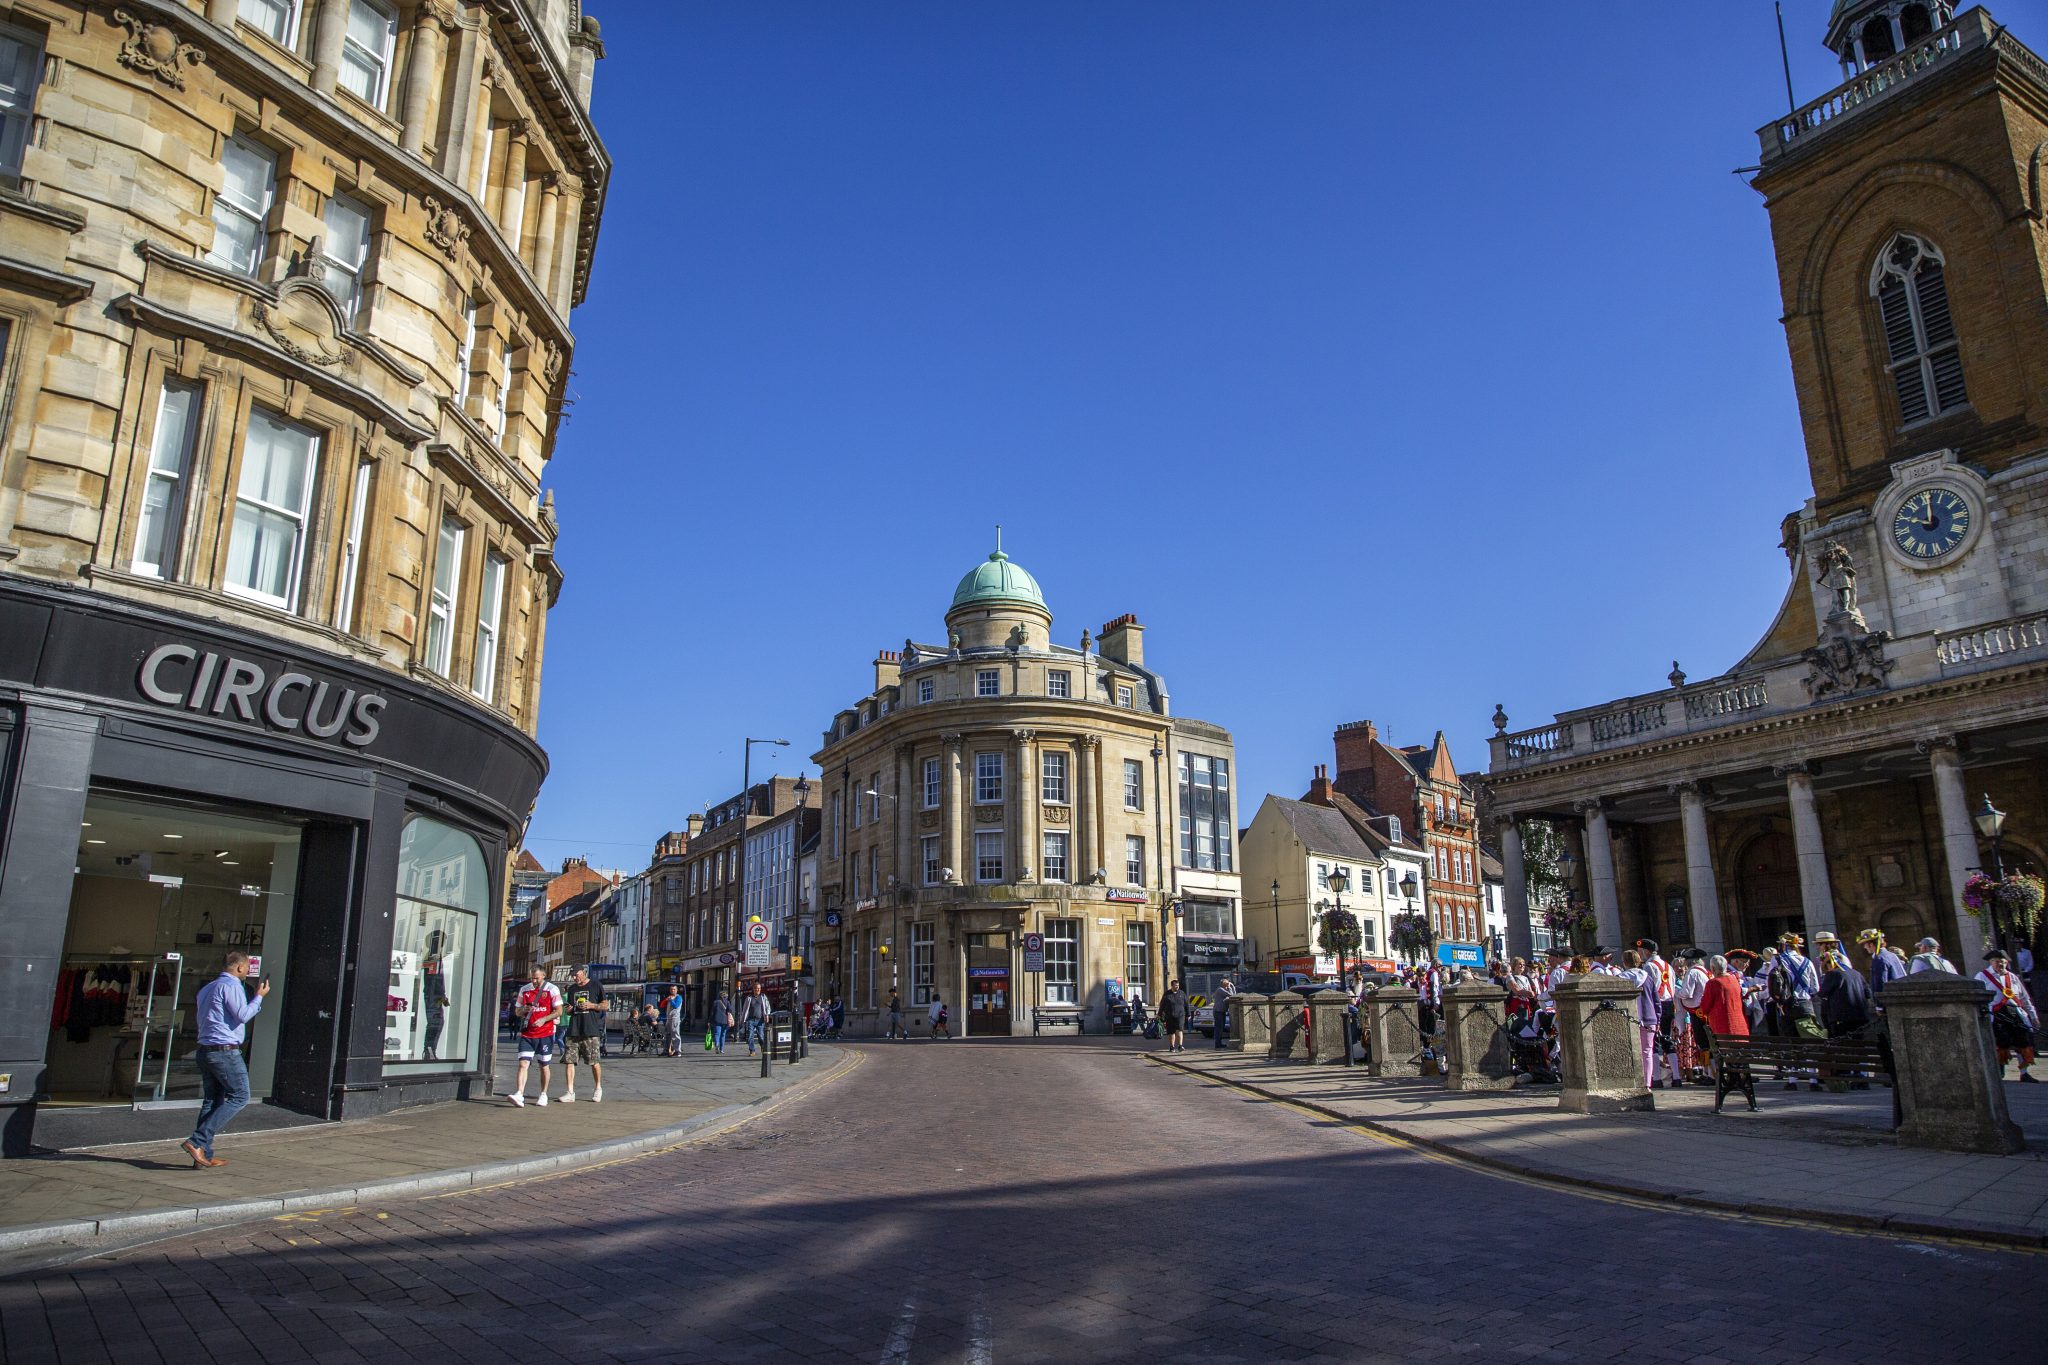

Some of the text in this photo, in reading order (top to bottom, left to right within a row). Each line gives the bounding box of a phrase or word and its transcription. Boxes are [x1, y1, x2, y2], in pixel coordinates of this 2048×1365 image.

[137, 643, 389, 747] CIRCUS
[1116, 888, 1148, 899] Nationwide
[1457, 950, 1478, 961] GREGGS
[1108, 985, 1120, 993] CASH
